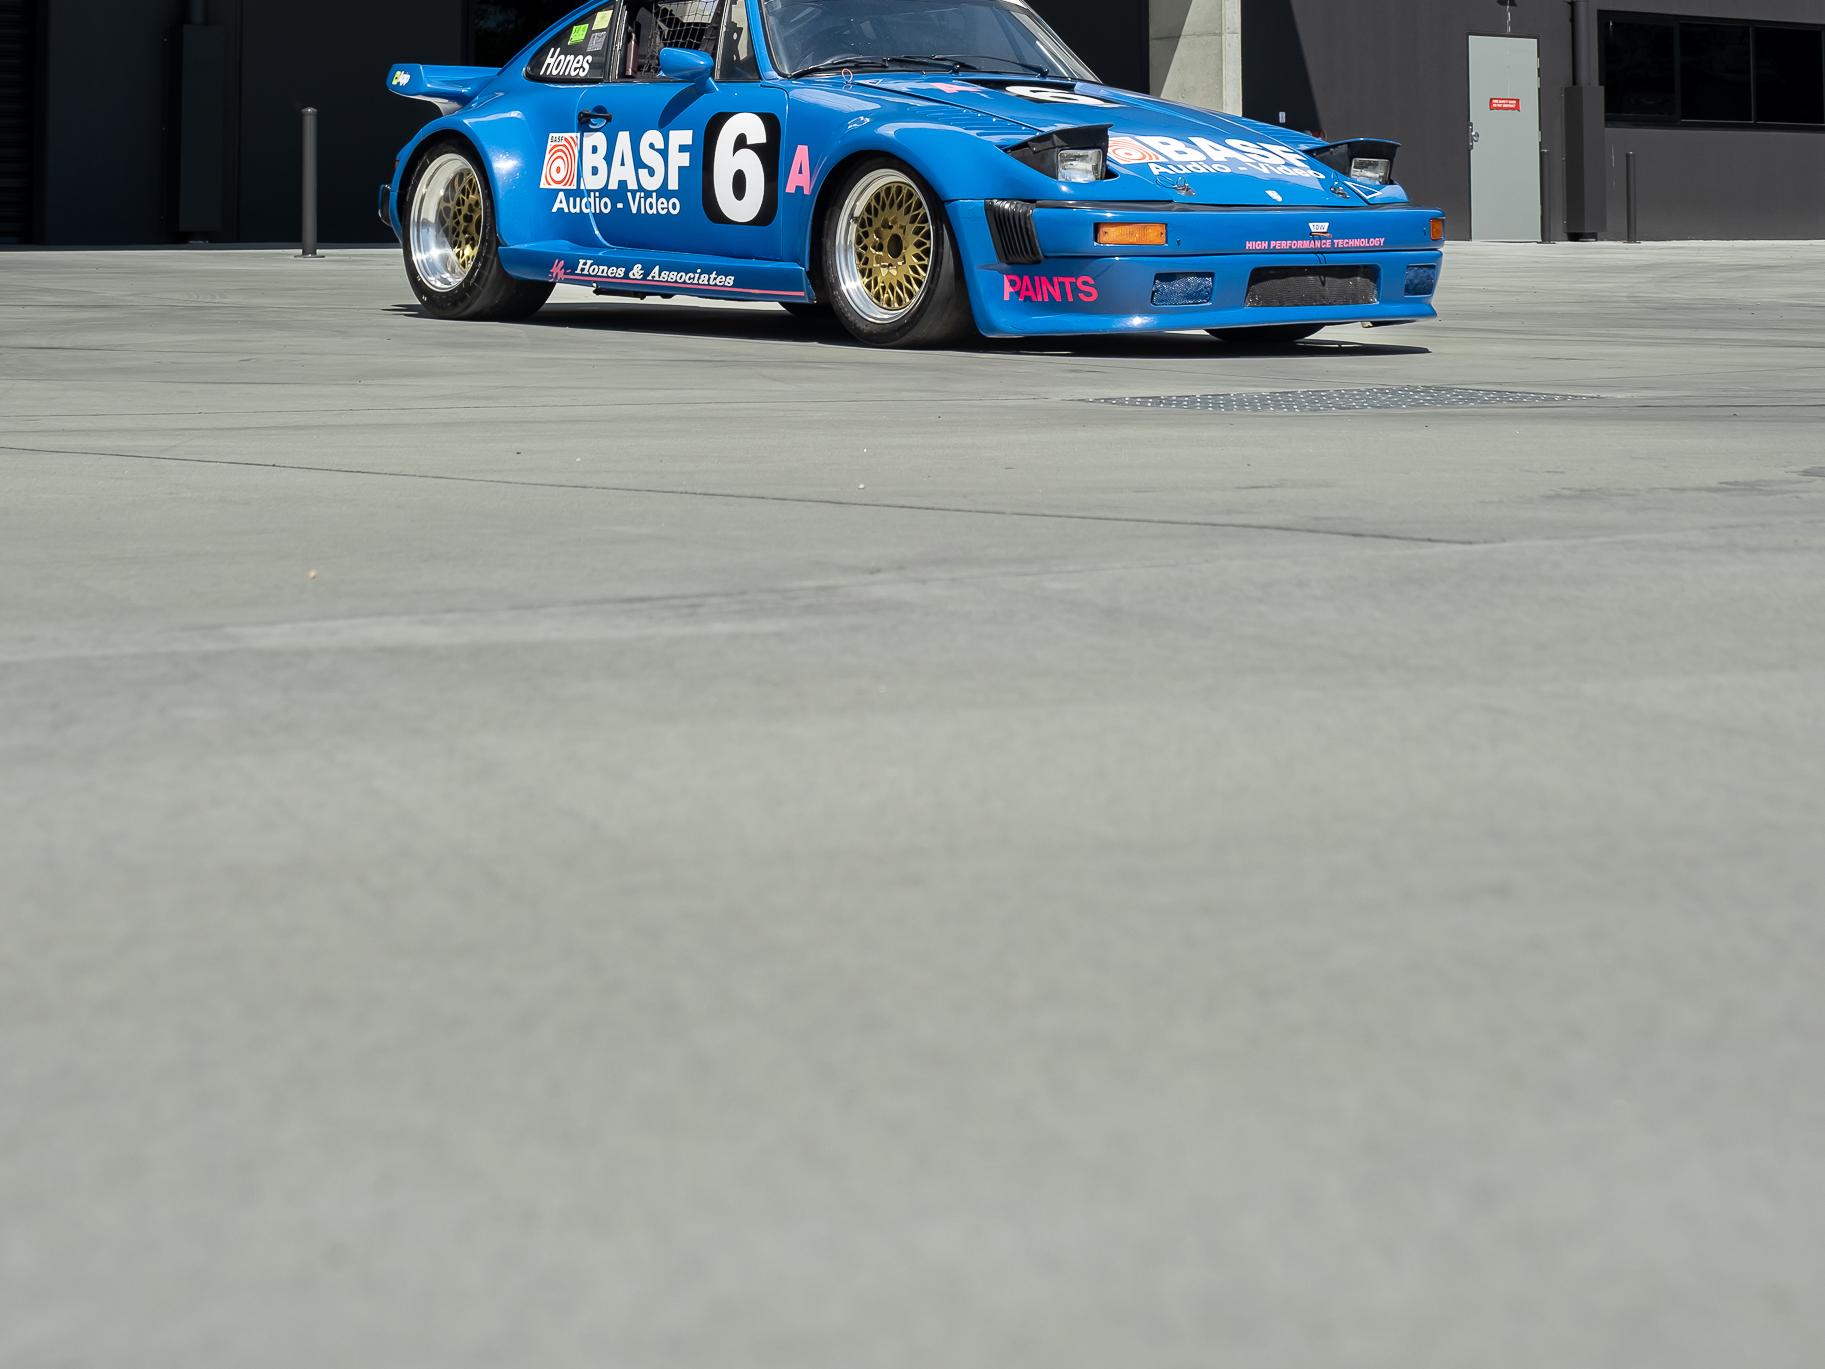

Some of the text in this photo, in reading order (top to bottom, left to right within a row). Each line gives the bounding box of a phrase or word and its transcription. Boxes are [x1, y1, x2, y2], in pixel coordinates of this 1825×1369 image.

[540, 47, 593, 77] Hones
[550, 135, 564, 143] BASF
[1135, 136, 1310, 169] BASF
[580, 130, 694, 191] BASF
[713, 112, 767, 223] 6
[785, 144, 811, 196] A
[1148, 161, 1232, 175] Audio
[1245, 162, 1326, 179] Video
[551, 191, 612, 214] Audio
[627, 192, 681, 215] Video
[1246, 238, 1385, 250] HIGH PERFORMANCE TECHNOLOGY
[575, 259, 626, 278] Hones
[628, 263, 645, 280] &
[647, 265, 735, 287] Associates
[1003, 274, 1099, 302] PAINTS
